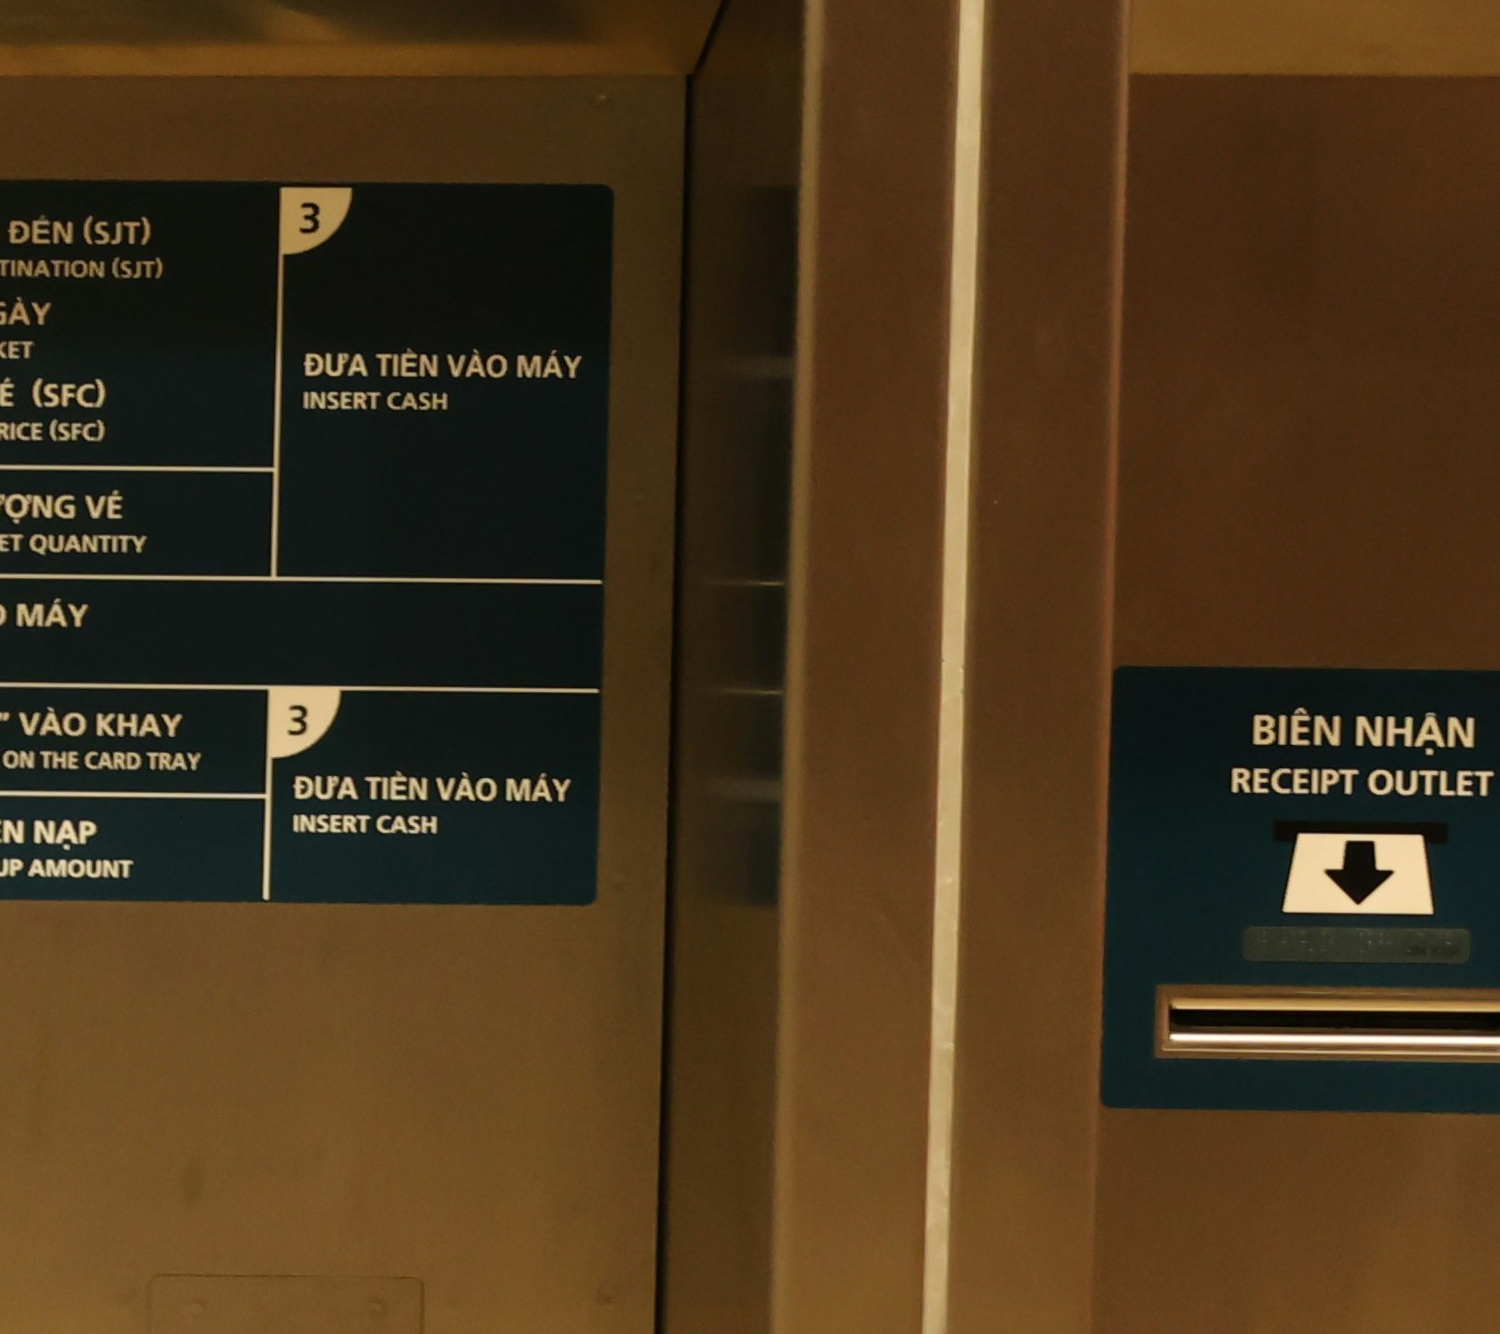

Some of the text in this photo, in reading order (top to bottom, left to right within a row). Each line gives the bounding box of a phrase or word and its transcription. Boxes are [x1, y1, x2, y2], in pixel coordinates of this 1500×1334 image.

[32, 378, 106, 408] (SFC)
[2, 750, 35, 769] ON
[39, 751, 79, 770] THE
[84, 751, 142, 770] CARD
[146, 752, 201, 771] TRAY
